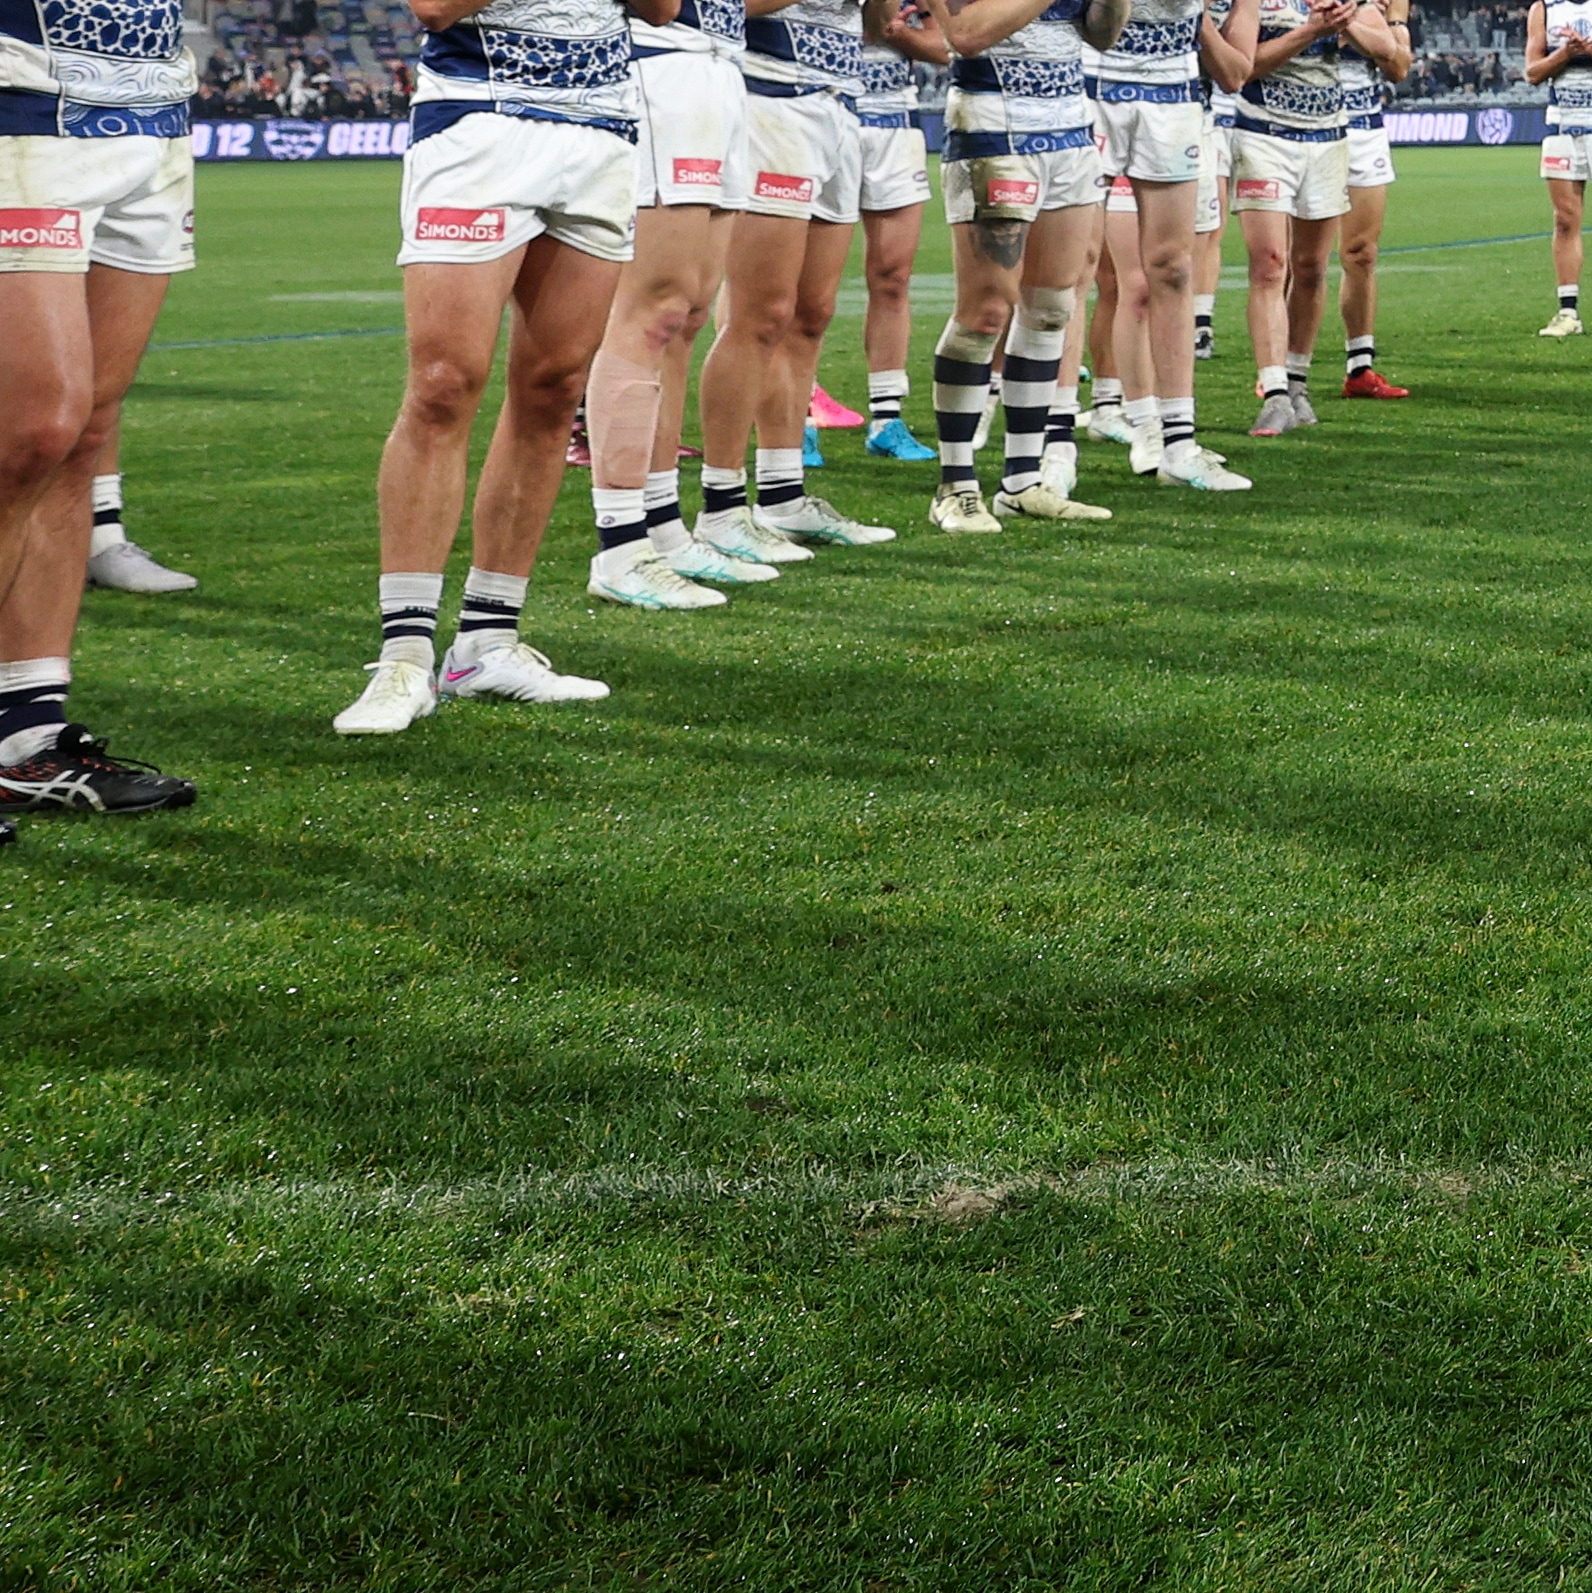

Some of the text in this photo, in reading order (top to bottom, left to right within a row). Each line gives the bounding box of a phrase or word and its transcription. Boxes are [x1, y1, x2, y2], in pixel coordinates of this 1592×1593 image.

[215, 123, 254, 157] 12
[1382, 112, 1469, 142] HMOND
[419, 220, 498, 240] SIMONDS
